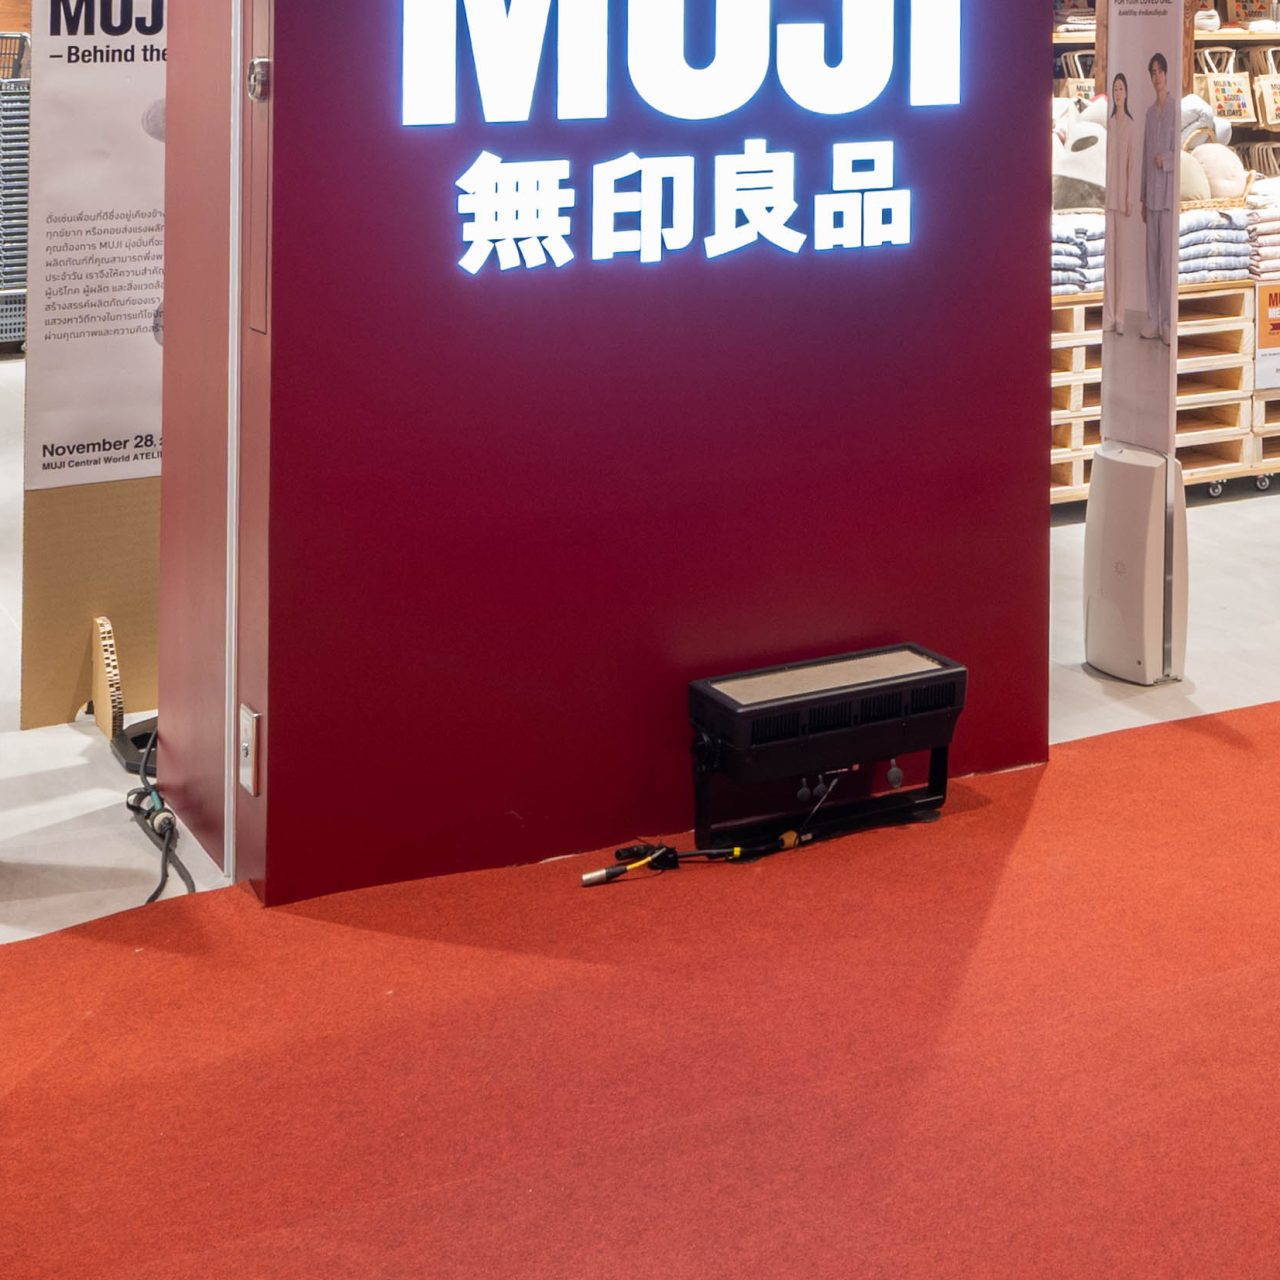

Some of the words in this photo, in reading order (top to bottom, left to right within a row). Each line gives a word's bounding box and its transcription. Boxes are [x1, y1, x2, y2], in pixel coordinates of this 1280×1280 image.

[455, 138, 911, 275] 無印良品
[99, 240, 123, 250] MUJI
[45, 250, 163, 267] ผลิตภัณฑ์ที่คุณสามารถพึ่งพ
[42, 439, 130, 458] November
[42, 461, 66, 471] MUJI
[67, 457, 101, 469] Central
[103, 454, 130, 465] World
